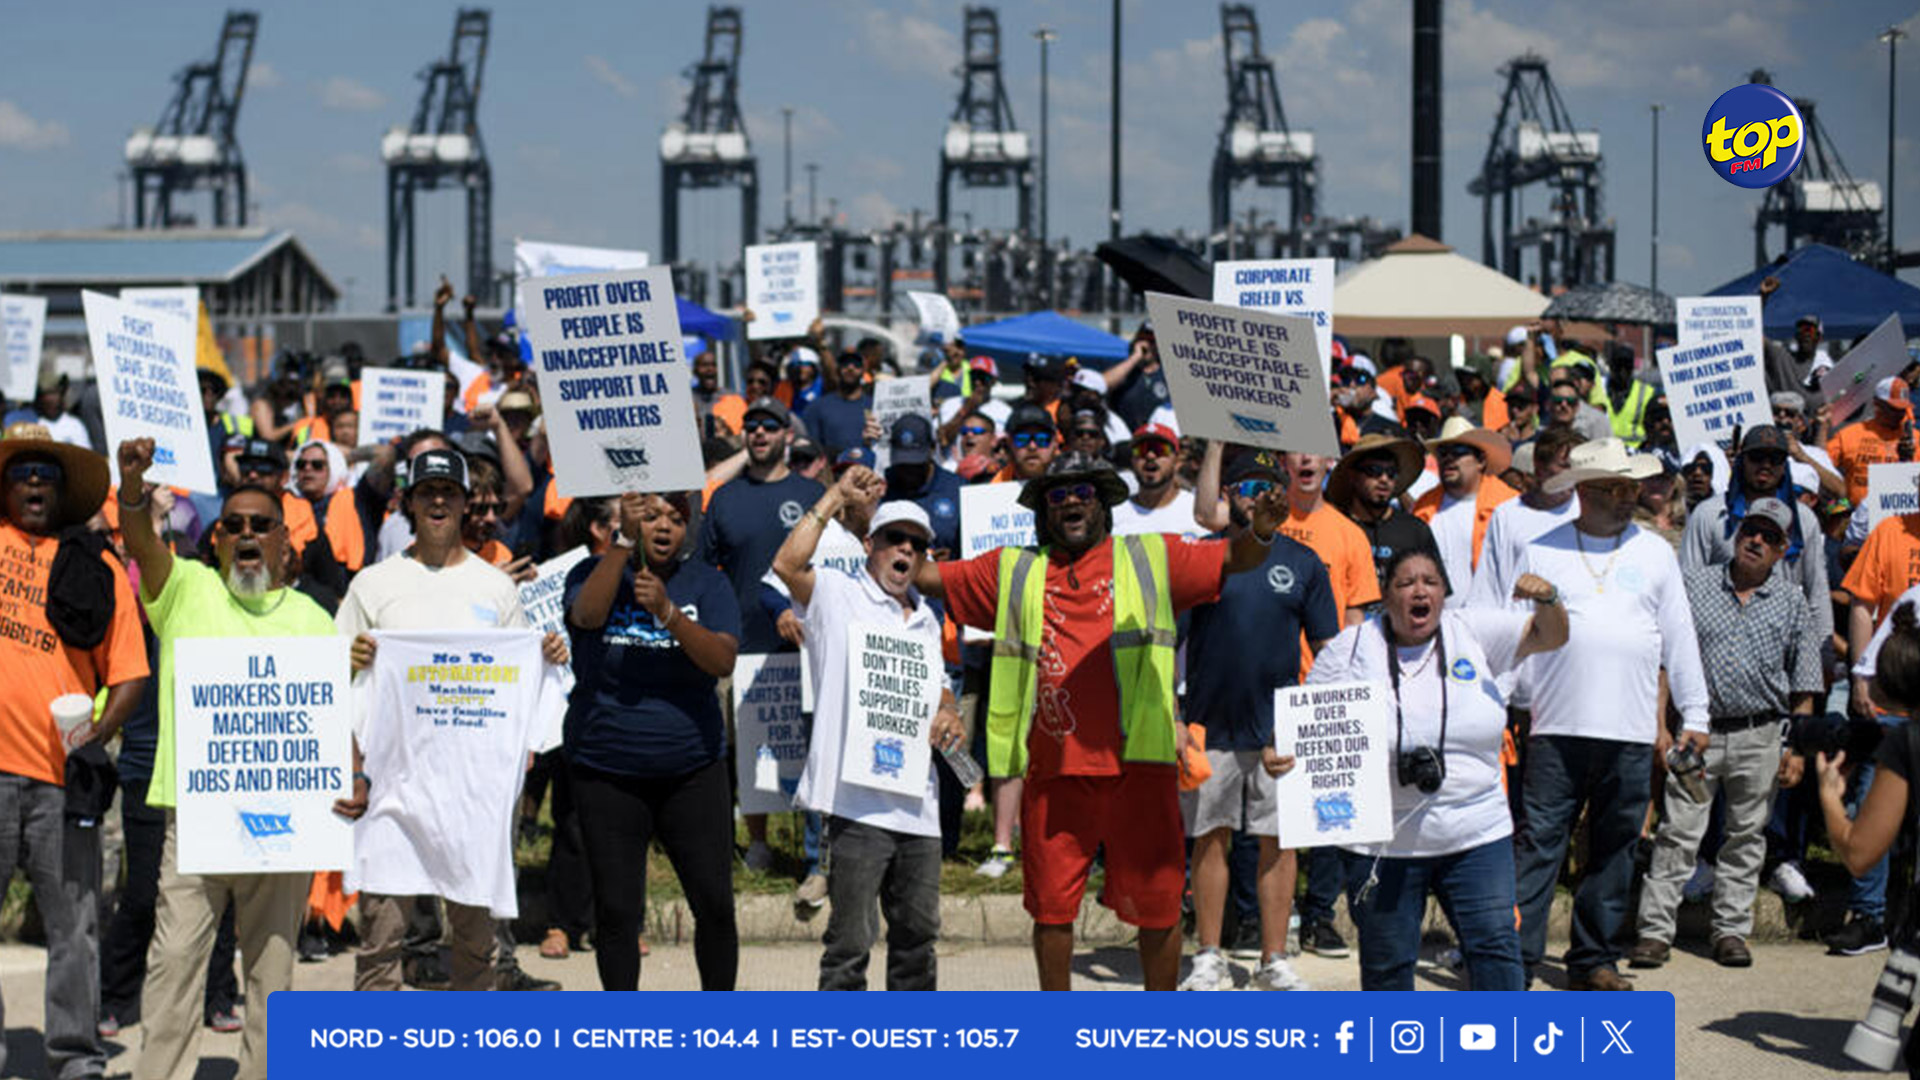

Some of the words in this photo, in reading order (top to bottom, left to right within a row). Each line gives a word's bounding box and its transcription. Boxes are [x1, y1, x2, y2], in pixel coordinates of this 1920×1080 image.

[1235, 267, 1311, 285] CORPORATE
[543, 284, 600, 310] PROFIT
[605, 280, 652, 305] OVER
[1239, 290, 1281, 307] GREED
[1691, 306, 1748, 317] AUTOMATION
[560, 315, 622, 341] PEOPLE
[625, 312, 644, 334] IS
[1177, 309, 1236, 334] PROFIT
[1242, 321, 1289, 341] OVER
[1194, 329, 1258, 354] PEOPLE
[1262, 341, 1281, 357] IS
[1672, 339, 1744, 365] AUTOMATION
[541, 341, 677, 373] UNACCEPTABLE:
[1172, 344, 1311, 379] UNACCEPTABLE:
[1190, 362, 1266, 389] SUPPORT
[1271, 376, 1301, 394] ILA
[1669, 361, 1732, 385] THREATENS
[1733, 355, 1756, 371] OUR
[559, 376, 636, 401] SUPPORT
[640, 373, 669, 396] ILA
[1205, 381, 1292, 409] WORKERS
[1685, 398, 1723, 417] STAND
[1725, 391, 1755, 408] WITH
[576, 405, 662, 431] WORKERS
[1703, 417, 1723, 431] THE
[1726, 411, 1745, 426] ILA
[991, 514, 1008, 530] NO
[971, 531, 1026, 550] WITHOUT
[433, 652, 461, 664] No
[469, 652, 494, 664] To
[865, 634, 924, 661] MACHINES
[248, 655, 276, 679] ILA
[407, 665, 521, 683] AUTOMATION!
[862, 652, 898, 674] DON'T
[900, 659, 928, 679] FEED
[192, 683, 281, 707] WORKERS
[285, 682, 334, 705] OVER
[429, 684, 495, 695] Machines
[742, 687, 781, 703] HURTS
[868, 672, 923, 698] FAMILIES:
[1290, 692, 1309, 707] ILA
[1312, 686, 1370, 705] WORKERS
[416, 705, 448, 715] have
[453, 706, 506, 718] families
[758, 706, 778, 722] ILA
[859, 690, 909, 716] SUPPORT
[912, 701, 928, 720] ILA
[1314, 705, 1346, 721] OVER
[213, 711, 313, 735] MACHINES:
[434, 717, 448, 726] to
[768, 725, 791, 741] FOR
[866, 712, 918, 738] WORKERS
[1298, 720, 1364, 738] MACHINES:
[208, 740, 279, 764] DEFEND
[283, 739, 319, 762] OUR
[1295, 739, 1342, 758] DEFEND
[1345, 736, 1369, 753] OUR
[1305, 756, 1334, 773] JOBS
[1337, 754, 1361, 770] AND
[186, 769, 230, 793] JOBS
[235, 768, 272, 792] AND
[277, 767, 342, 791] RIGHTS
[1312, 772, 1355, 789] RIGHTS
